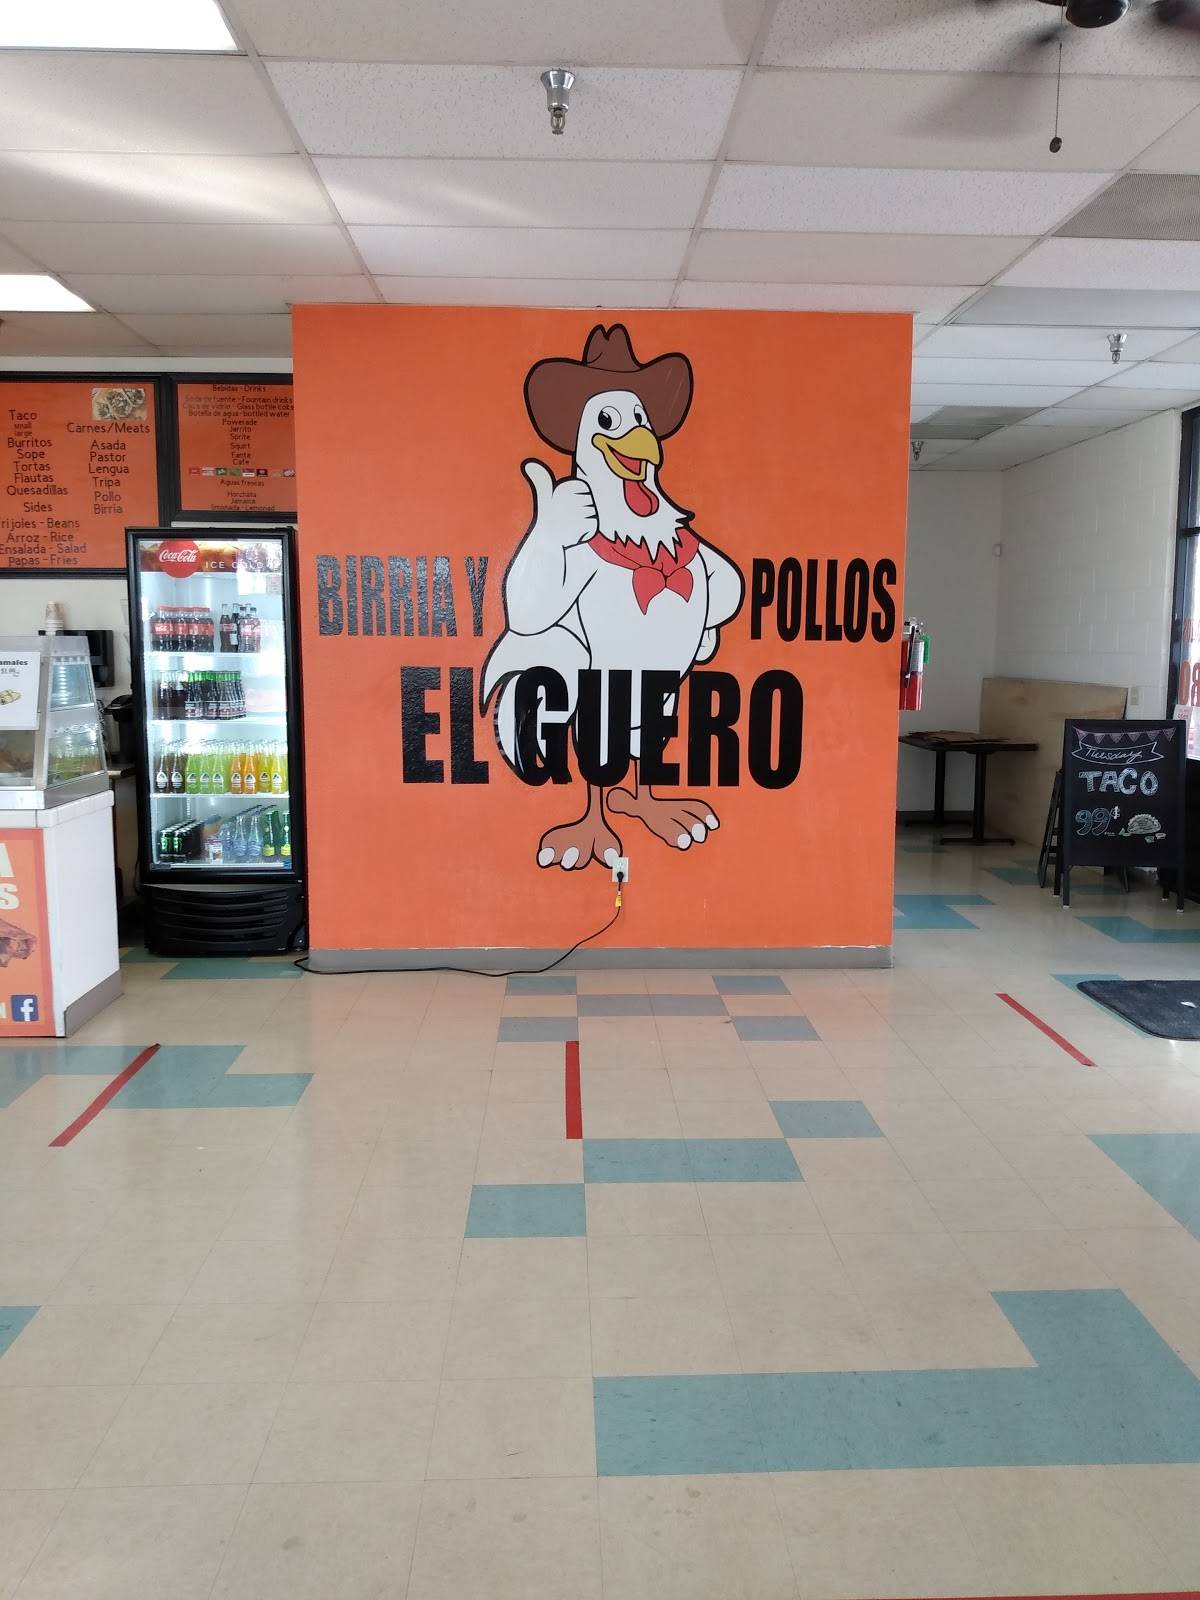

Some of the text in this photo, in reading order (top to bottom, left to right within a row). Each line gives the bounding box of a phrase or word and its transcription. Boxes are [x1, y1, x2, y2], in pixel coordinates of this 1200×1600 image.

[241, 395, 271, 403] Fountain
[272, 396, 293, 404] drinks
[8, 410, 38, 421] Taco
[66, 422, 151, 434] Carnes/Meats
[7, 437, 53, 448] Burritos
[230, 433, 251, 441] Sprite
[90, 440, 126, 450] Asada
[17, 449, 45, 461] Sope
[90, 452, 126, 462] Pastor
[13, 461, 51, 472] Tortas
[88, 463, 129, 476] Lengua
[14, 473, 54, 483] Flautas
[92, 477, 121, 488] Tripa
[6, 485, 69, 496] Quesadillas
[94, 491, 122, 501] Pollo
[24, 502, 53, 513] Sides
[93, 504, 123, 515] Birria
[0, 517, 37, 531] rijoles
[47, 517, 80, 529] Beans
[6, 532, 40, 543] Arroz
[50, 531, 74, 542] Rice
[0, 543, 47, 554] Ensalada
[56, 543, 88, 553] Salad
[8, 556, 40, 568] Papas
[50, 554, 79, 565] Fries
[159, 549, 199, 563] Coca-Cola
[205, 561, 225, 569] ICE
[316, 555, 897, 643] BIRRIA Y POLLOS
[401, 666, 804, 789] EL GUERO
[1078, 768, 1159, 796] TACO
